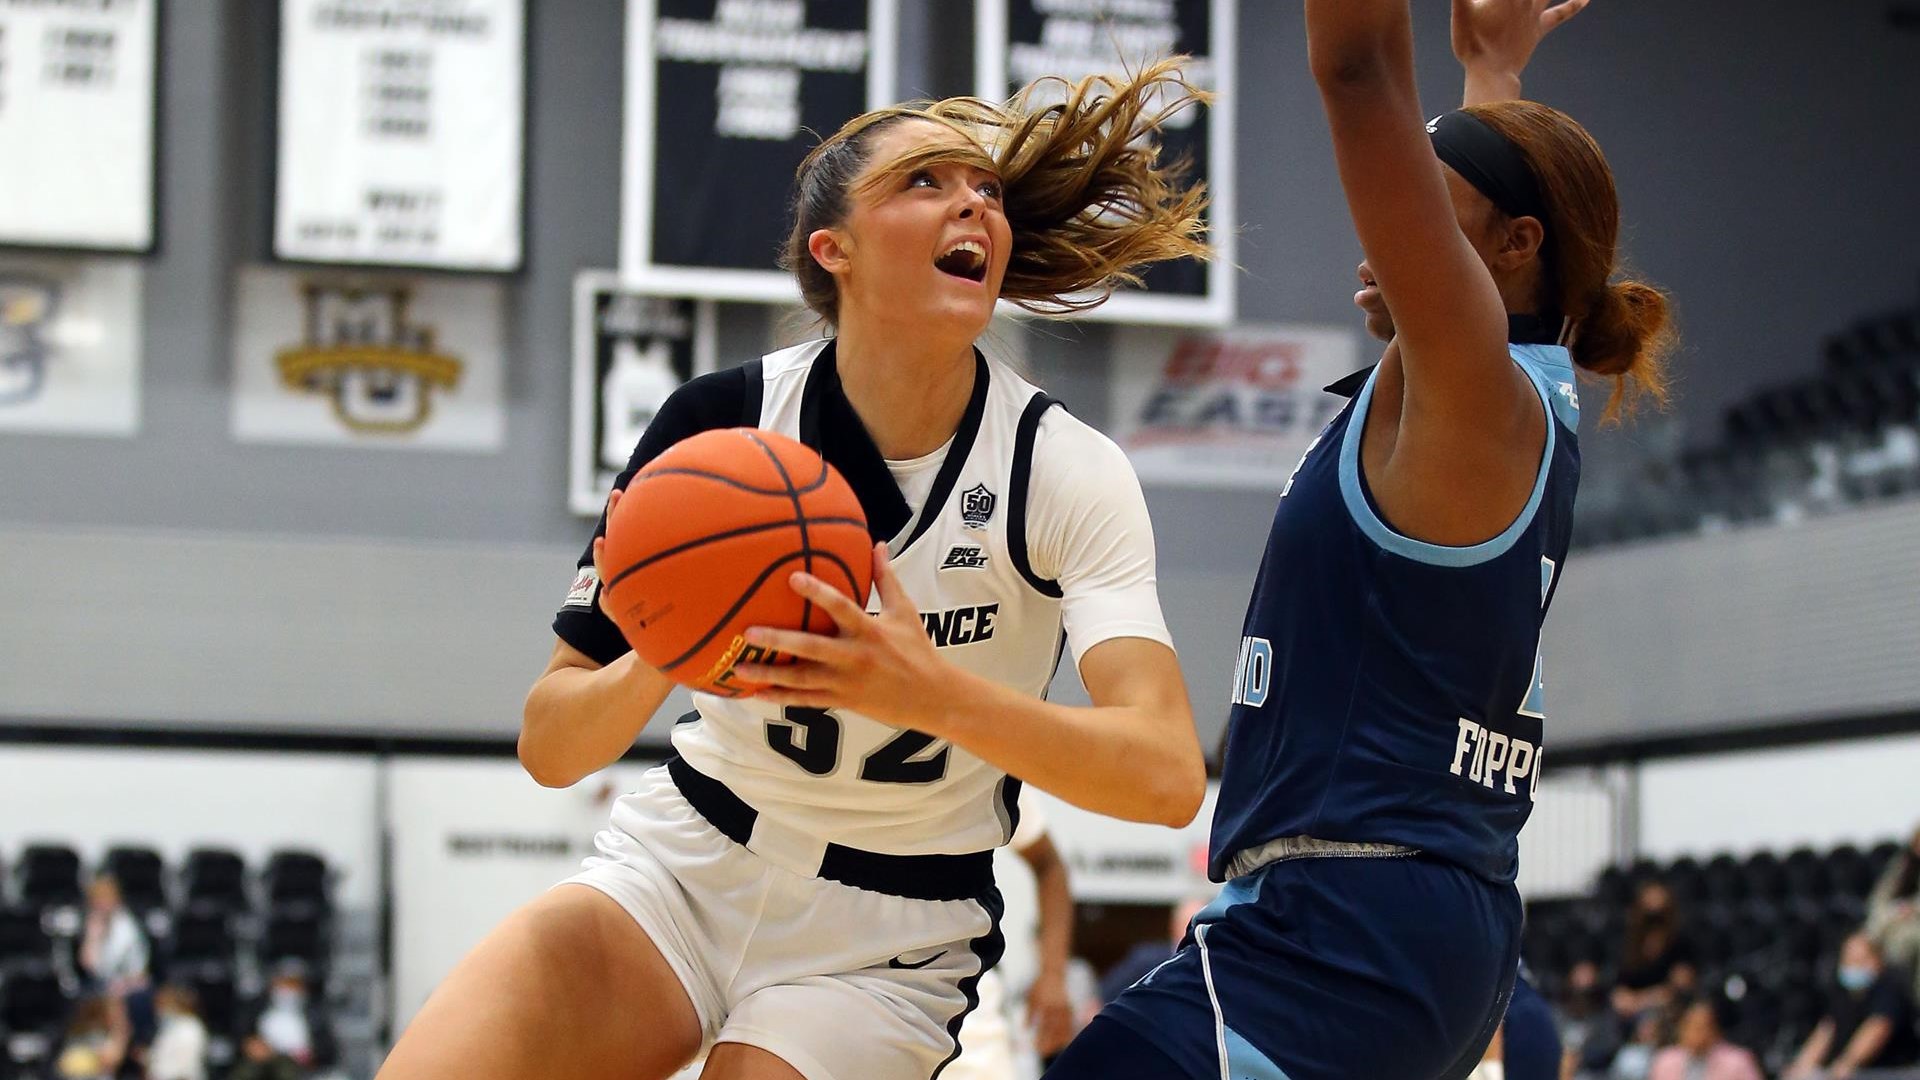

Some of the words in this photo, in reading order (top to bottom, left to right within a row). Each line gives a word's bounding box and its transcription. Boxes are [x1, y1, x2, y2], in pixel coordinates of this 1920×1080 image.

[966, 494, 991, 513] 50
[949, 547, 981, 557] BIG
[943, 556, 989, 566] EAST
[763, 704, 953, 785] 32
